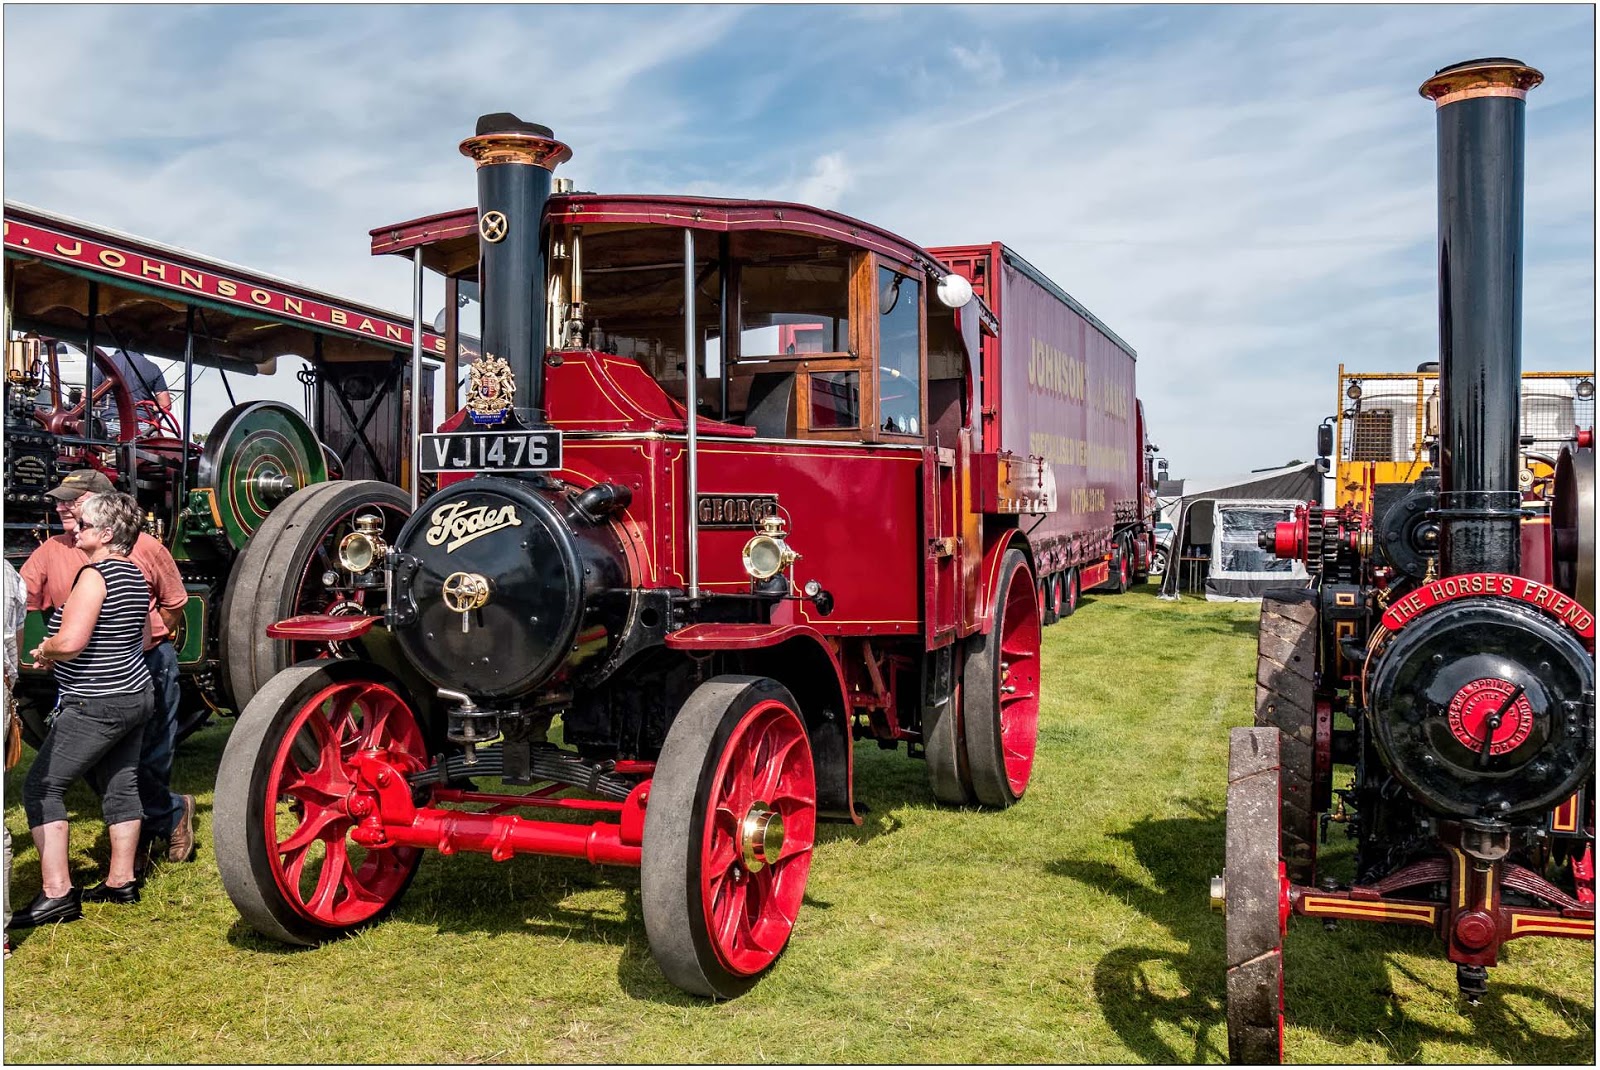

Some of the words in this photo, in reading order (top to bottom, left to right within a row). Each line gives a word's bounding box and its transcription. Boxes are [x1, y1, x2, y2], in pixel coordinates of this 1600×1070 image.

[331, 309, 447, 351] BANS
[425, 500, 522, 554] Foden
[1387, 593, 1426, 623] THE
[1431, 575, 1514, 601] HORSE'S
[1522, 583, 1592, 631] FRIEND
[1469, 741, 1509, 754] MOR
